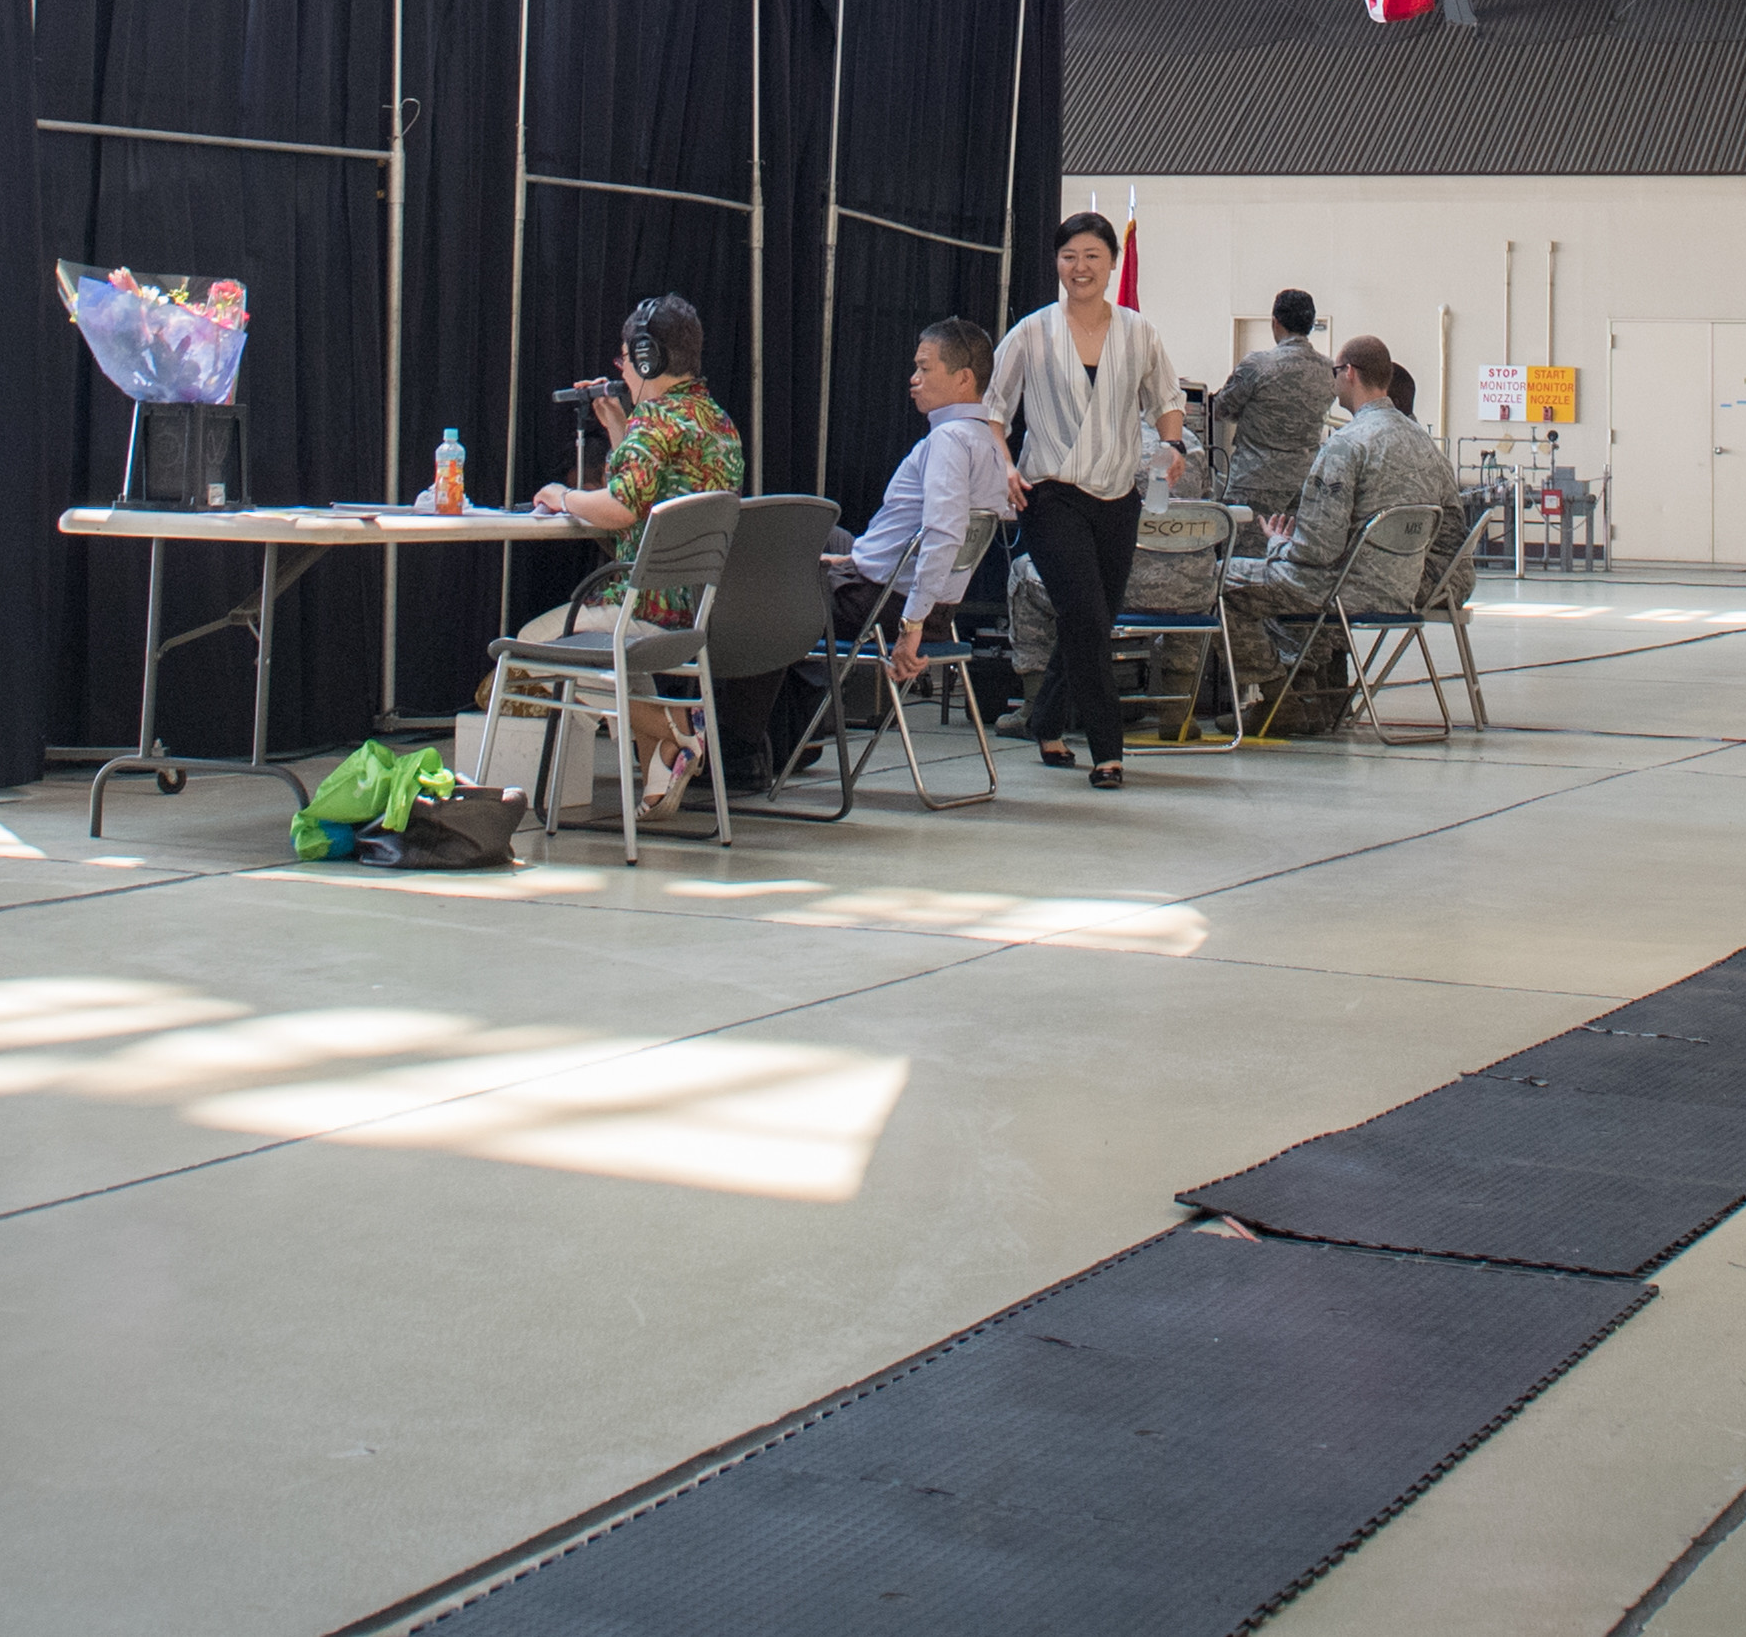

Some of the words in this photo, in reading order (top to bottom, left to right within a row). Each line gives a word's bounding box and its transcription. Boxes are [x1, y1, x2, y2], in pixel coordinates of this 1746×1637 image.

[1488, 368, 1518, 378] STOP
[1534, 369, 1566, 380] START
[1479, 381, 1526, 391] MONITOR
[1527, 382, 1574, 393] MONITOR
[1483, 393, 1522, 404] NOZZLE
[1530, 394, 1571, 405] NOZZLE
[1138, 519, 1210, 537] SCOTT
